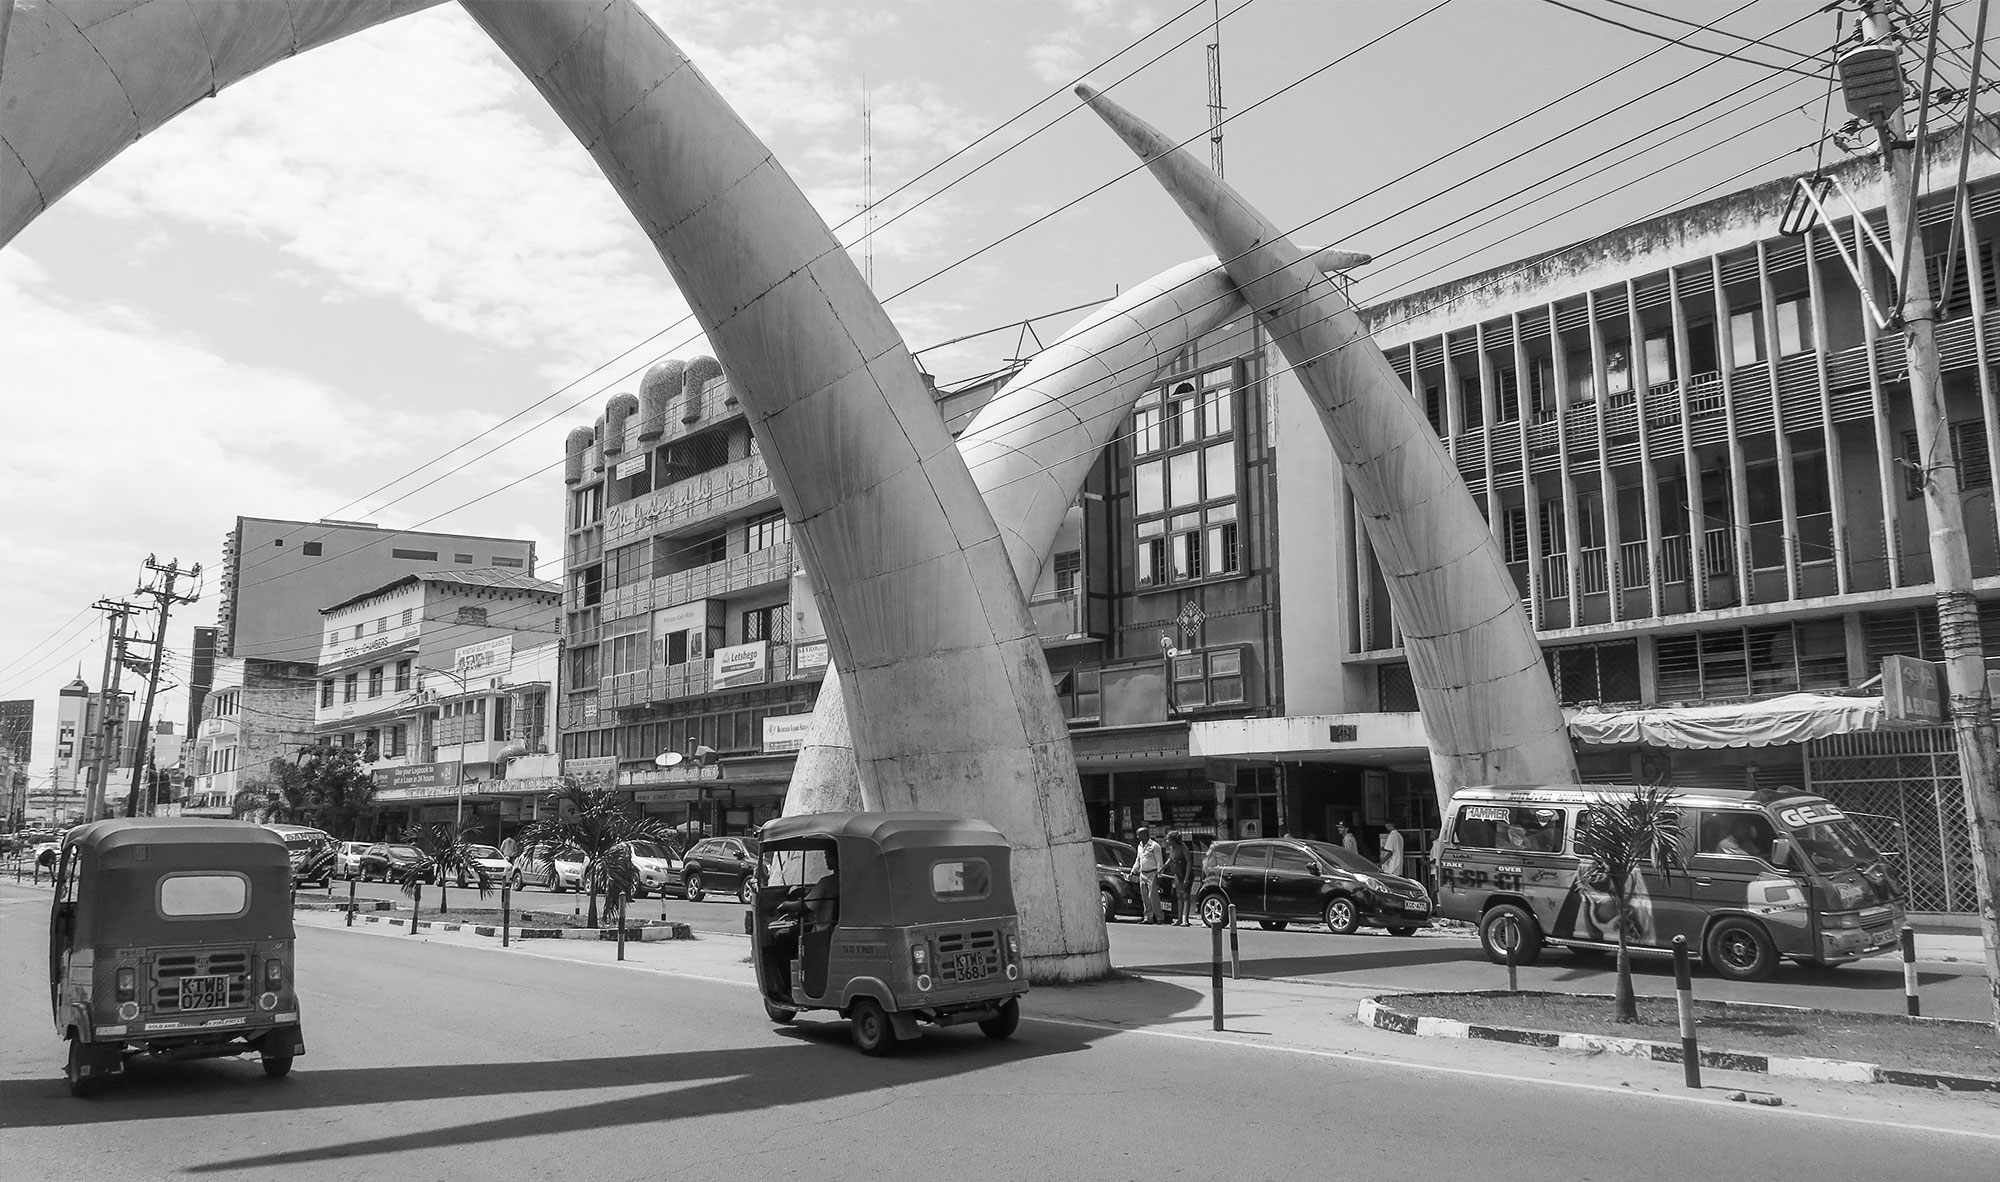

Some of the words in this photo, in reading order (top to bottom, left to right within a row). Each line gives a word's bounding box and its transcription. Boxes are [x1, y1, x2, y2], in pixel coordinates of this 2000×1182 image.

[731, 651, 758, 662] Letshego
[412, 766, 428, 774] Logbook
[423, 774, 435, 782] hours
[1466, 807, 1510, 821] HAMMER
[955, 952, 984, 968] KTWB
[957, 965, 987, 981] 368J
[182, 977, 224, 993] KTWB
[182, 993, 226, 1009] 079H
